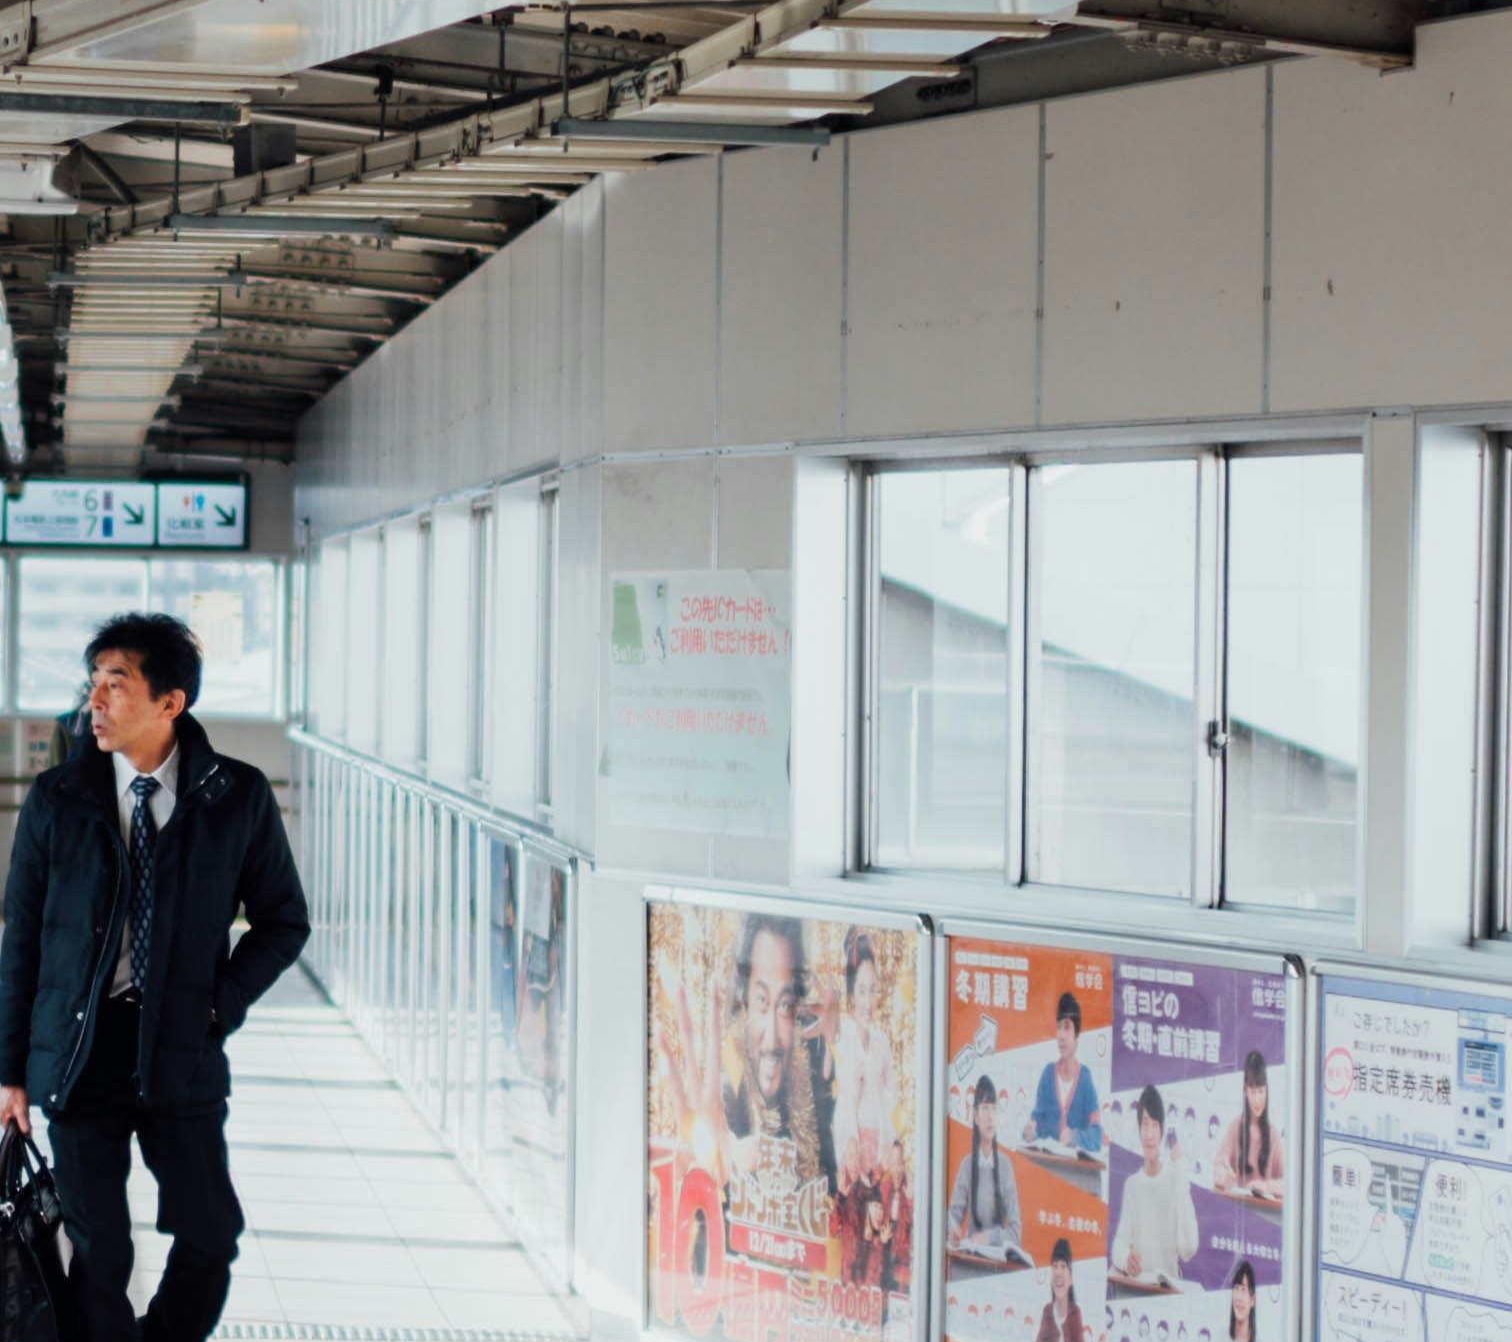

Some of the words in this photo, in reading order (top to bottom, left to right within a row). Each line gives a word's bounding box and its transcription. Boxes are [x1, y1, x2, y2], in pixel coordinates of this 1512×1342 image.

[83, 490, 99, 511] 6
[85, 516, 99, 538] 7
[954, 968, 1029, 1012] 冬期講習
[1121, 984, 1180, 1021] 信ヨビの
[1121, 1017, 1221, 1065] 冬期・直前講習
[1352, 1061, 1453, 1107] 指定席券売機
